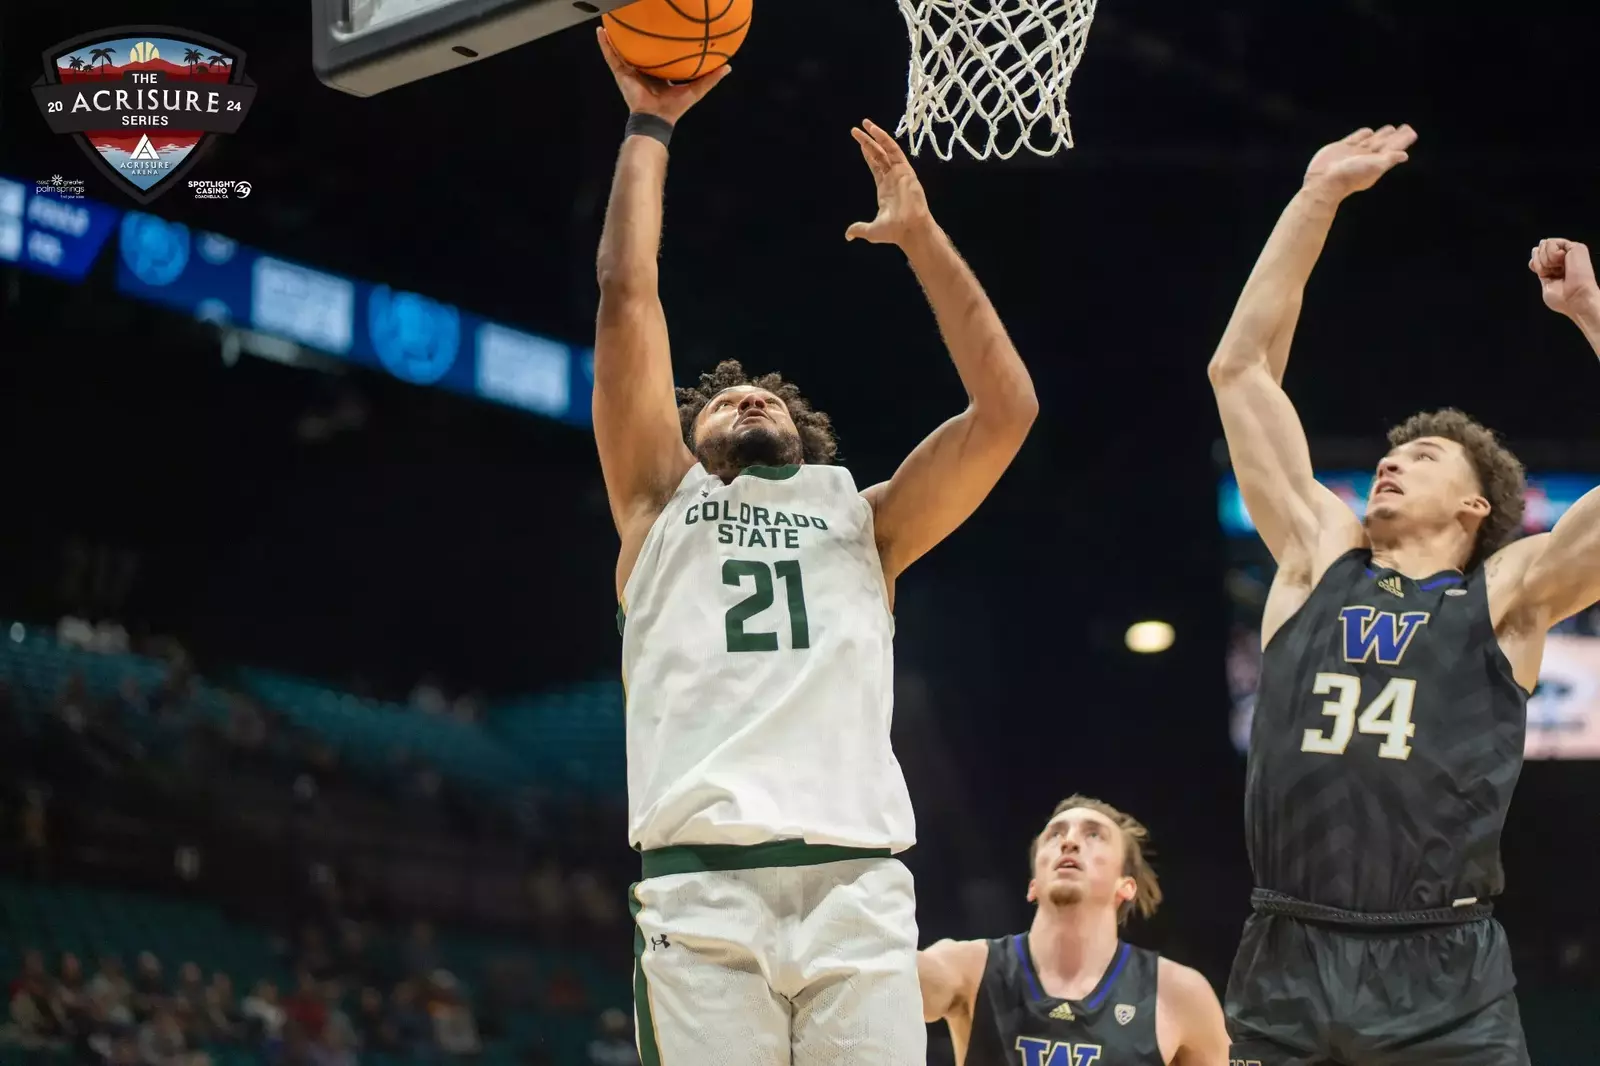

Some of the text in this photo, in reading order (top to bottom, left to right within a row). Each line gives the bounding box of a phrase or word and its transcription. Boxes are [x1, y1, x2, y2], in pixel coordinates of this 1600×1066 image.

[685, 500, 829, 531] COLORADO
[718, 523, 800, 549] STATE
[722, 558, 810, 652] 21
[1338, 605, 1430, 664] W
[1300, 672, 1417, 760] 34
[1015, 1036, 1101, 1066] W
